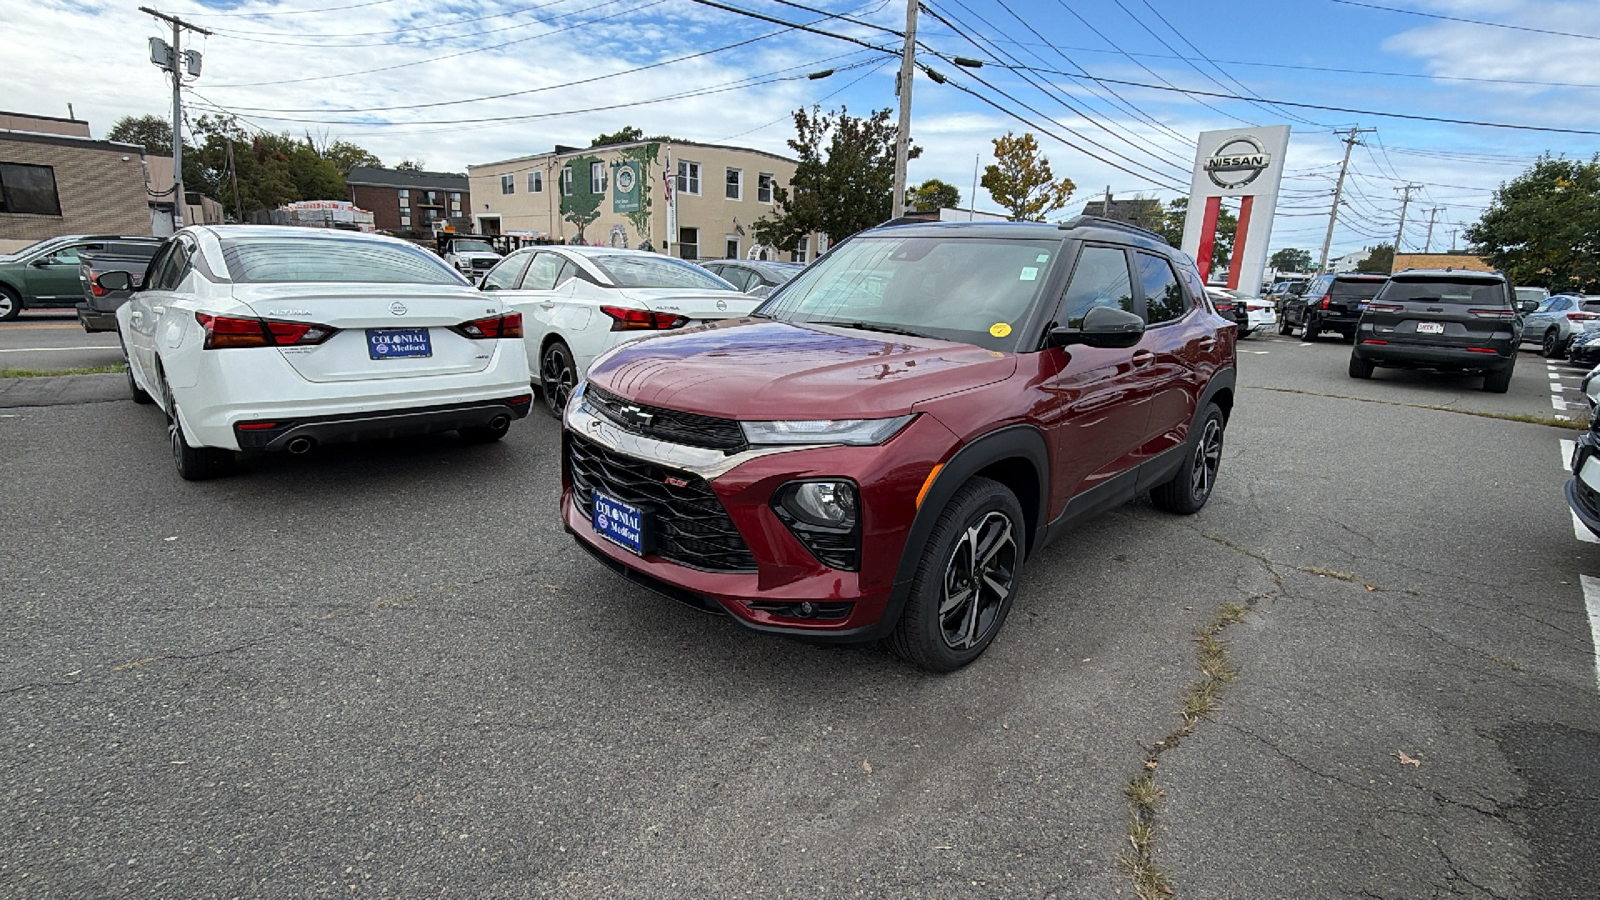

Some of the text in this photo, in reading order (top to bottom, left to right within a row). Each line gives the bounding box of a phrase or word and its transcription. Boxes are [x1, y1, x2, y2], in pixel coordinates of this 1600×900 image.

[1209, 156, 1263, 167] NISSAN
[372, 334, 426, 344] COLONIAL
[391, 343, 426, 352] Medford
[664, 477, 688, 488] RS
[595, 500, 641, 532] COLONIAL
[610, 521, 639, 543] Medford
